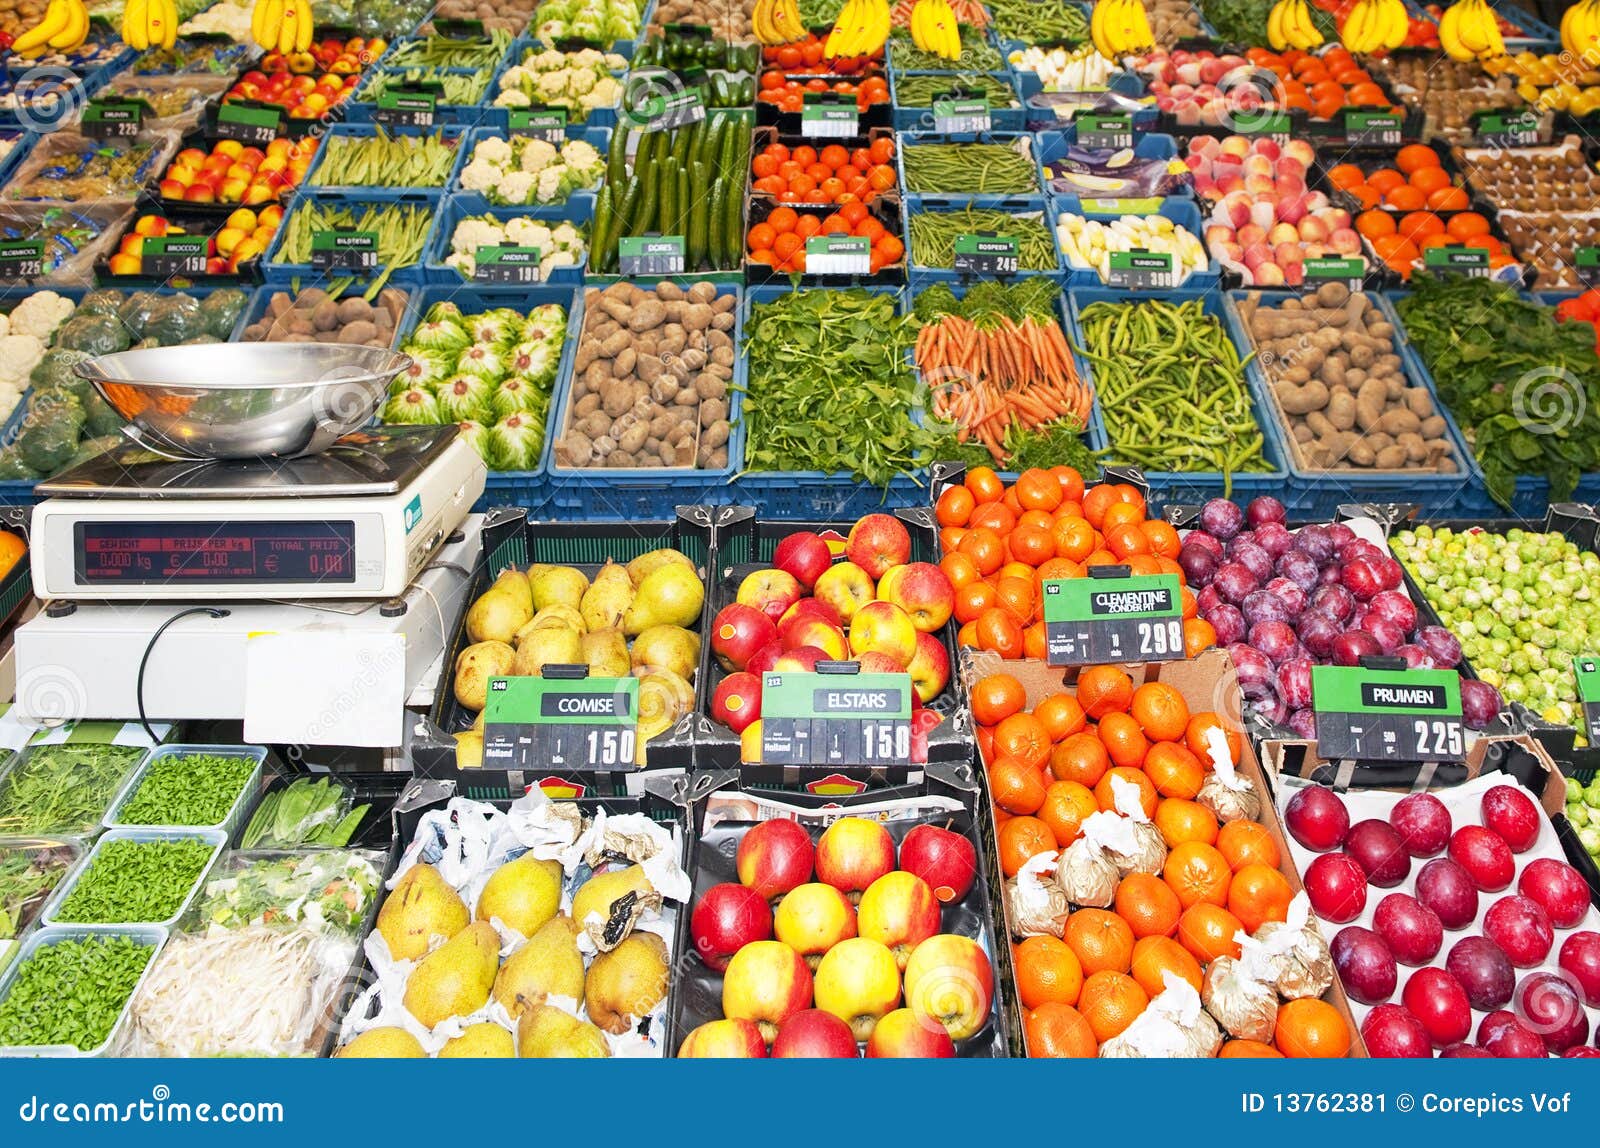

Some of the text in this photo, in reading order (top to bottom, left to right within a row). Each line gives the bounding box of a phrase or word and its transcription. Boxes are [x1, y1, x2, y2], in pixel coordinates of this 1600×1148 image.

[118, 122, 138, 136] 225
[255, 126, 277, 141] 225
[20, 261, 41, 275] 225
[185, 256, 208, 272] 150
[996, 256, 1018, 272] 245
[208, 540, 226, 550] PER
[270, 540, 339, 551] TOTAAL PRIJS
[137, 552, 152, 570] kg
[1096, 590, 1167, 606] CLEMENTINE
[1108, 603, 1156, 614] ZONDER PIT
[1137, 620, 1183, 655] 298
[1049, 643, 1075, 655] Spanje
[828, 692, 887, 709] ELSTARS
[1373, 687, 1434, 705] PRUIMEN
[558, 698, 614, 713] COMISE
[863, 724, 910, 759] 150
[1414, 720, 1462, 755] 225
[486, 748, 513, 758] Holland
[587, 729, 635, 765] 150
[764, 742, 791, 752] Holland
